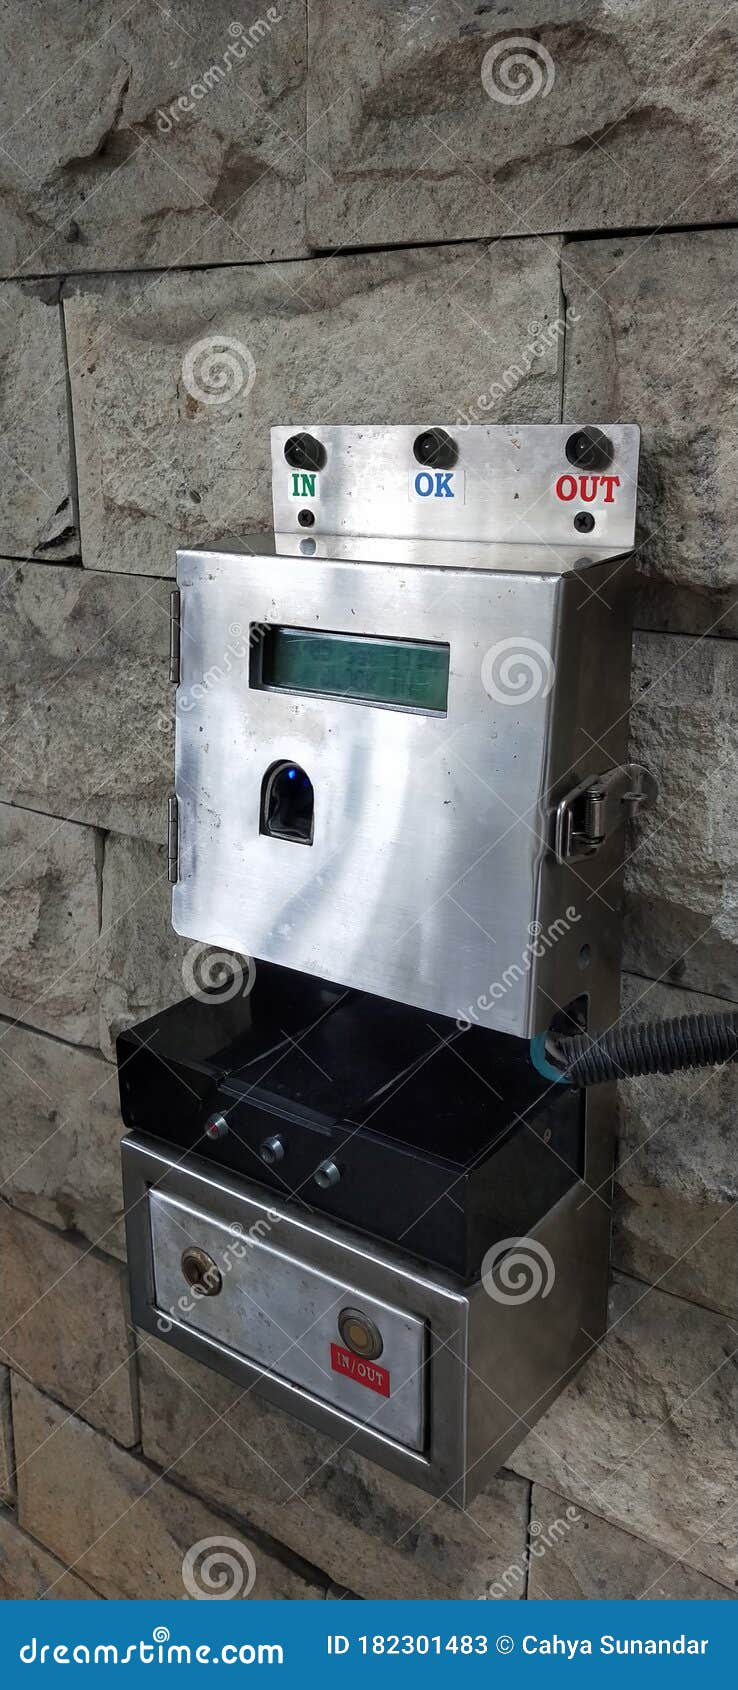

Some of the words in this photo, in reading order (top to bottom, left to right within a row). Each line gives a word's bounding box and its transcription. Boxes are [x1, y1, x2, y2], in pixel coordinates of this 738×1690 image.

[292, 473, 317, 497] IN
[414, 472, 455, 498] OK
[555, 474, 620, 503] OUT
[336, 1352, 384, 1386] IN/OUT
